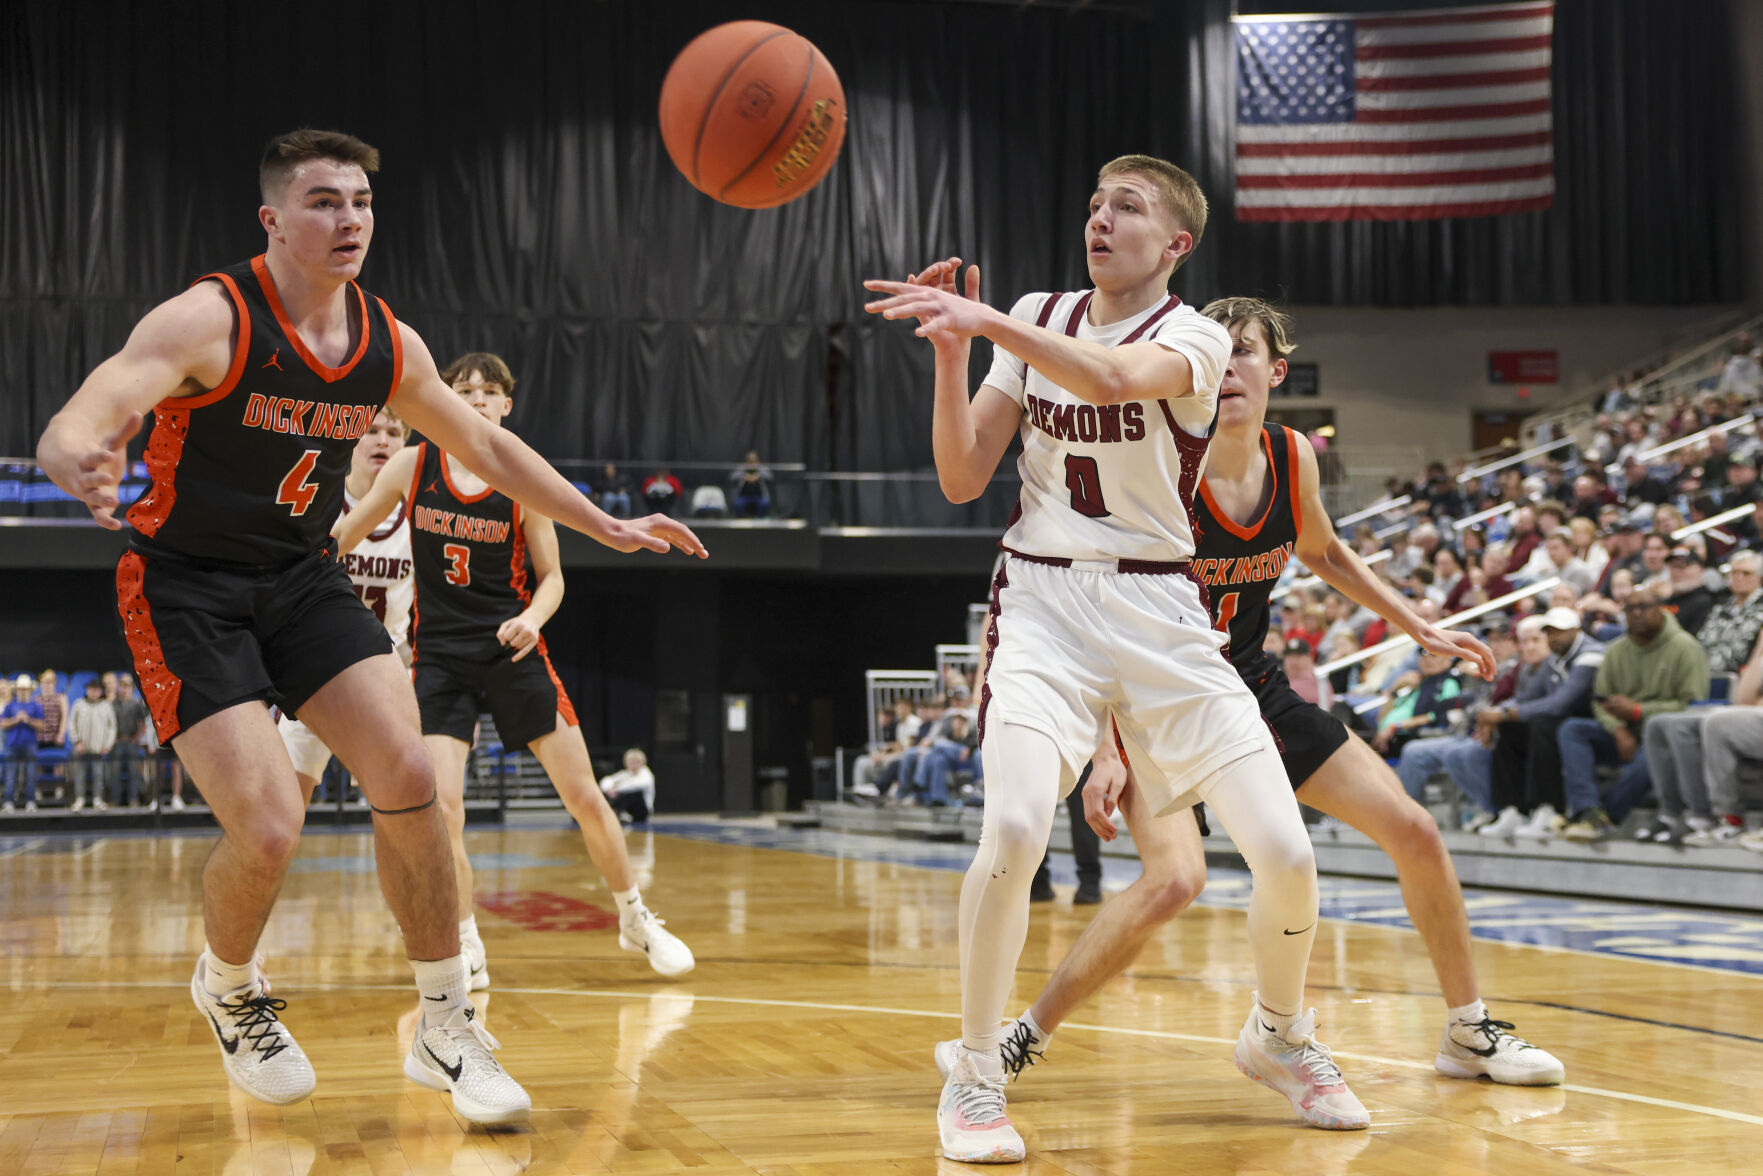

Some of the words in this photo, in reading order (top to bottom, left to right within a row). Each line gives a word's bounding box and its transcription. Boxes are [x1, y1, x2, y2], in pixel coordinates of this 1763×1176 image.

[242, 392, 377, 440] DICKINSON
[1027, 393, 1146, 443] DEMONS
[275, 449, 321, 517] 4
[1064, 452, 1112, 518] 0
[415, 505, 510, 543] DICKINSON
[344, 553, 411, 580] EMONS
[444, 543, 470, 587] 3
[1190, 541, 1293, 586] ICKINSON
